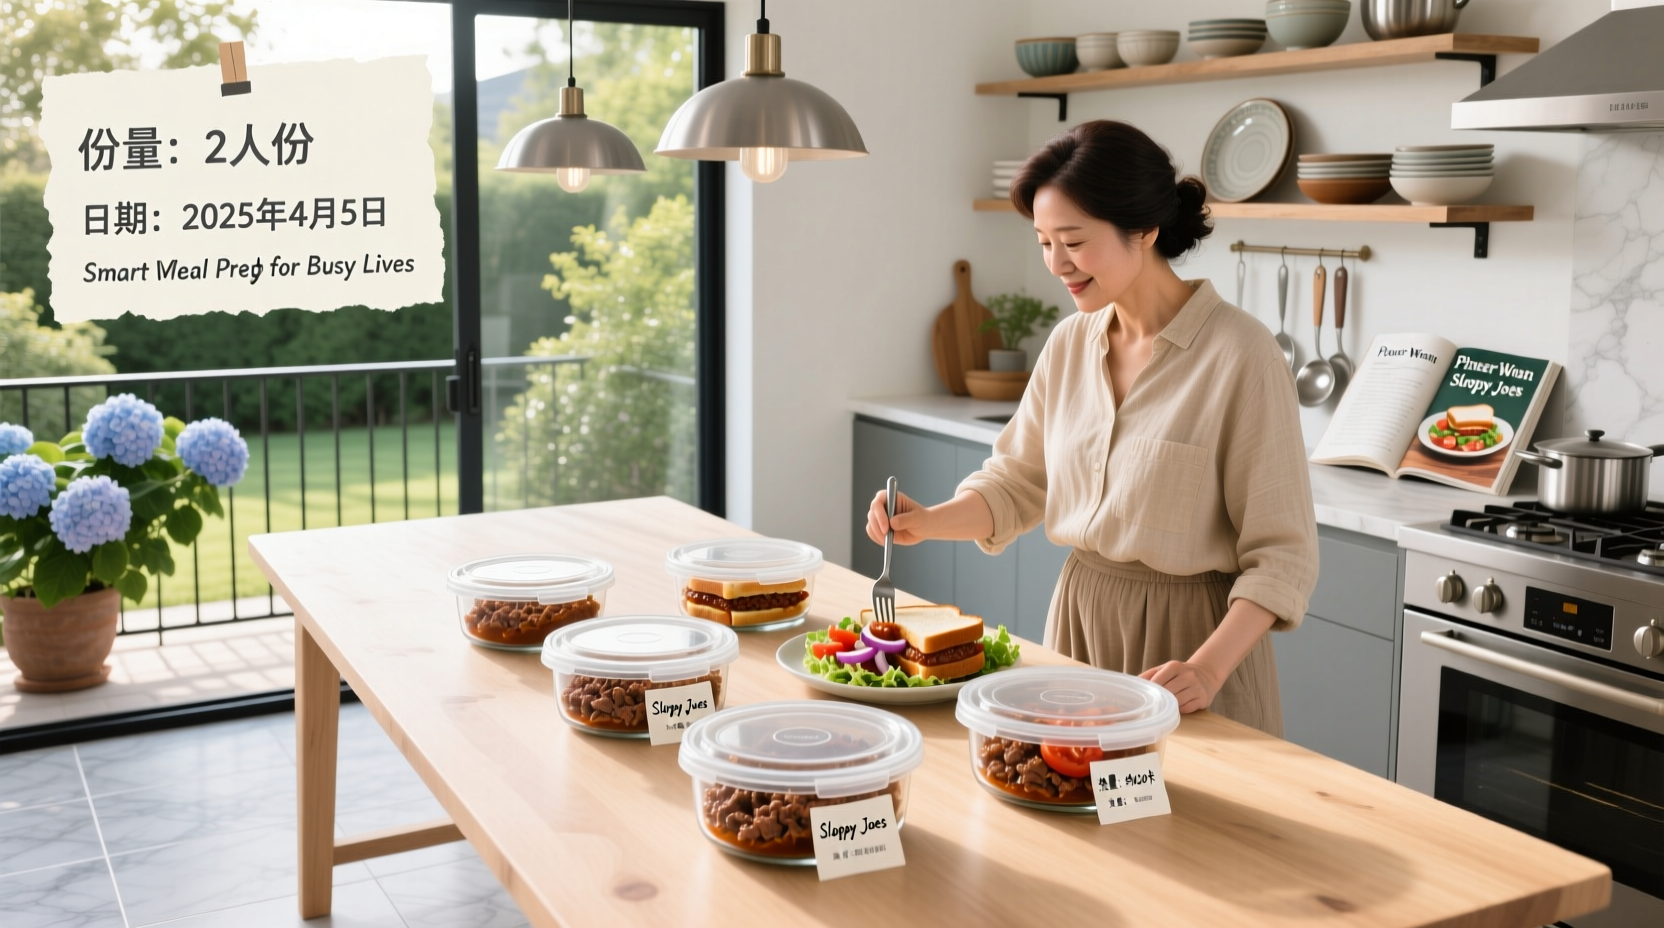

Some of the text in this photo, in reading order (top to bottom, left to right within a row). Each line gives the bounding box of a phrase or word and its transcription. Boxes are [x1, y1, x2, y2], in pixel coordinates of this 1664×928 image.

[85, 197, 385, 235] 日期：2025年4月5日
[83, 262, 150, 283] Smart
[157, 258, 209, 281] Meal
[270, 255, 301, 277] for
[307, 254, 357, 283] Busy
[363, 254, 415, 275] Lives
[820, 816, 888, 841] Sloppy Joes
